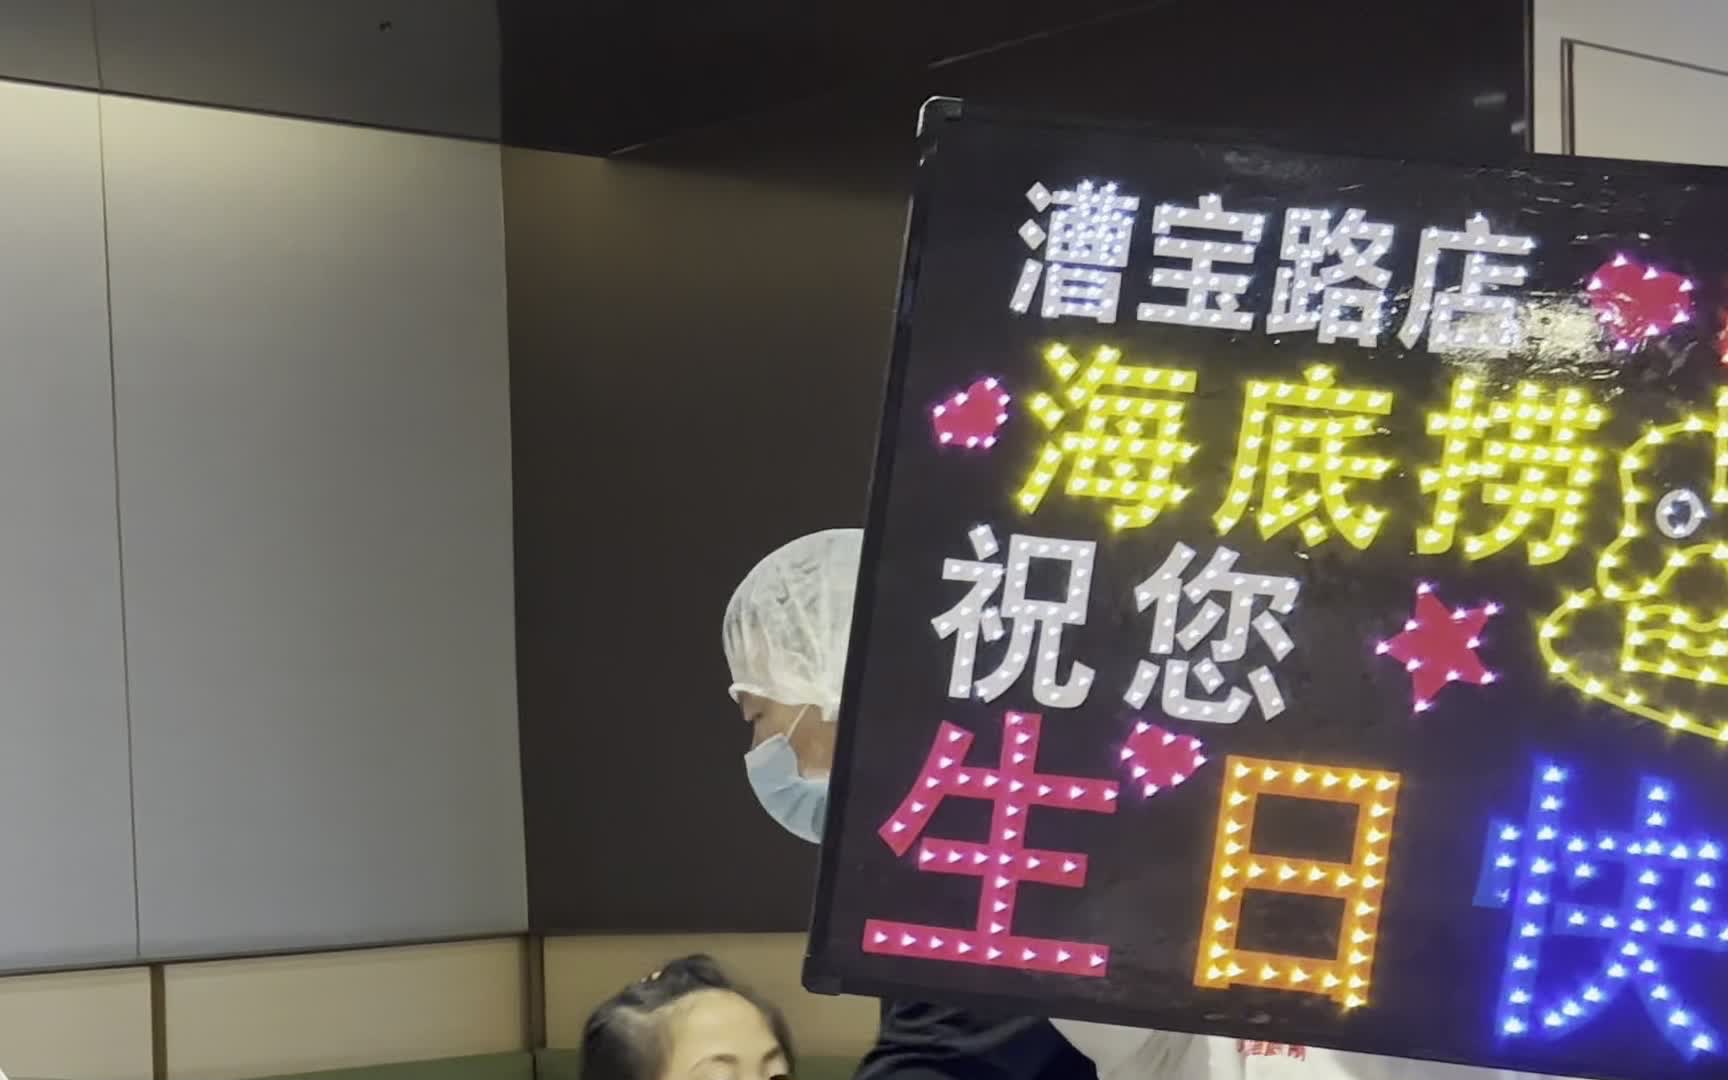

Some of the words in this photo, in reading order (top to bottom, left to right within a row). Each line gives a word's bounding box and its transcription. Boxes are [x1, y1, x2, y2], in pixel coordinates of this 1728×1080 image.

[1010, 180, 1536, 357] 漕宝路店
[1015, 342, 1609, 566] 海底捞
[931, 526, 1302, 724] 祝您
[861, 711, 1728, 1058] 生日快
